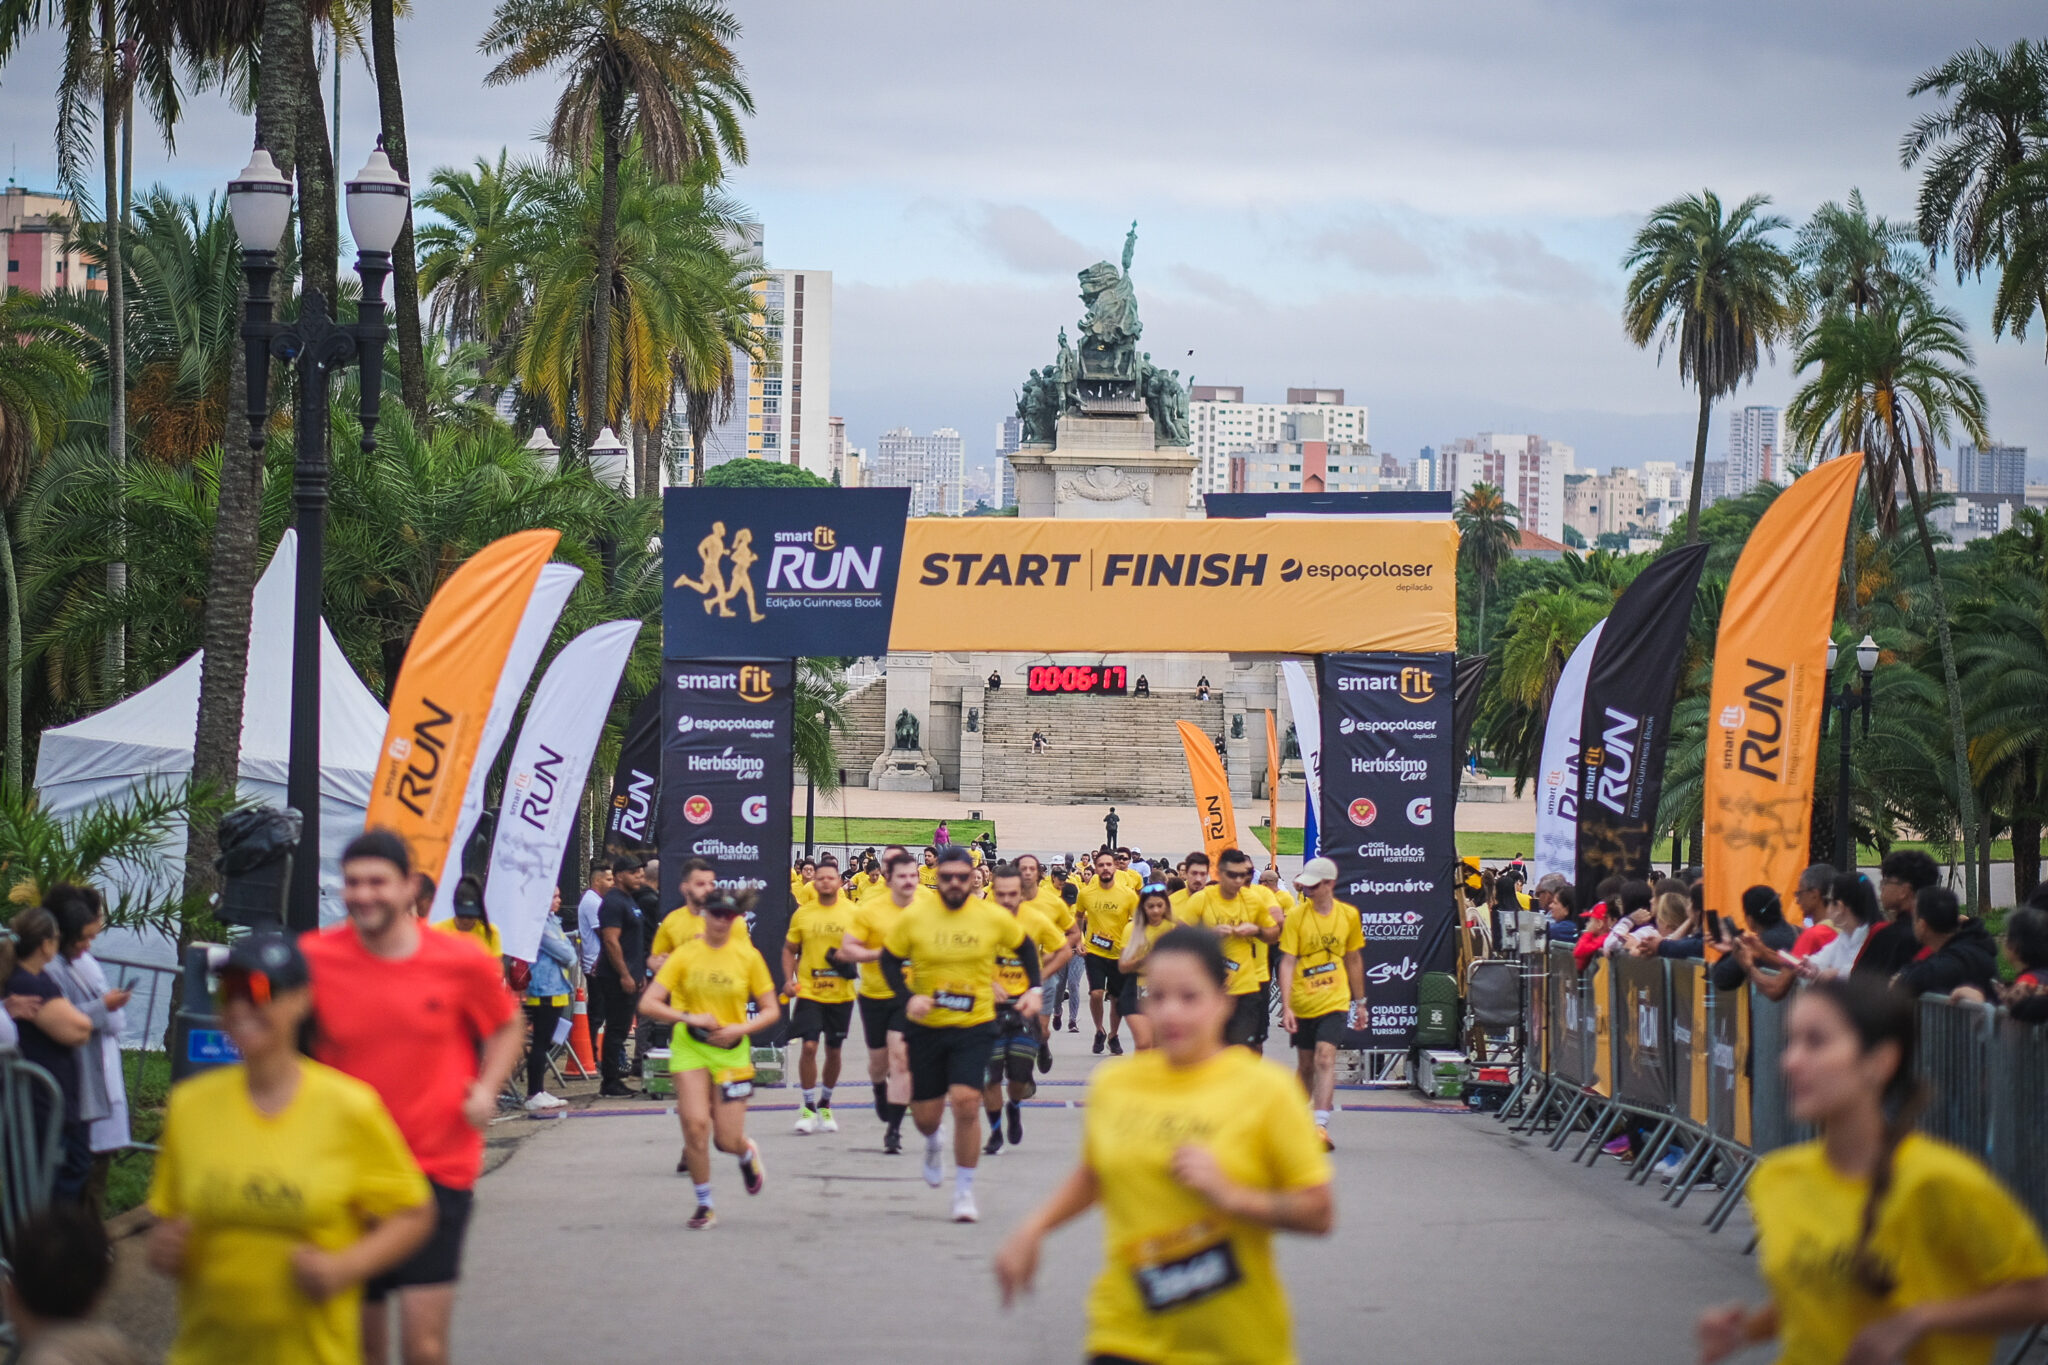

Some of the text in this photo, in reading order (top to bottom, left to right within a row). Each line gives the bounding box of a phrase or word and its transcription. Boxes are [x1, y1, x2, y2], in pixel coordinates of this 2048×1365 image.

[766, 546, 882, 589] RUN
[919, 552, 1268, 588] START FINISH
[1306, 561, 1433, 581] espaçolaser
[1396, 583, 1433, 592] depilação
[765, 597, 882, 609] Edição Guinness Book
[695, 717, 775, 732] espaçolaser
[1356, 719, 1437, 733] espaçolaser
[1738, 658, 1787, 782] RUN
[1643, 716, 1655, 740] Book
[397, 696, 453, 817] RUN
[1597, 707, 1638, 814] RUN
[736, 768, 764, 781] Care
[1400, 769, 1428, 782] Care
[520, 743, 564, 831] RUN
[620, 769, 654, 840] RUN
[1205, 795, 1225, 840] RUN
[692, 842, 759, 855] Cunhados
[1358, 844, 1424, 857] Cunhados
[1361, 912, 1402, 924] MAX
[1361, 924, 1424, 936] RECOVERY
[1371, 1005, 1407, 1015] CIDADE
[1371, 1014, 1398, 1027] SÃO
[1371, 1028, 1406, 1036] TURISMO
